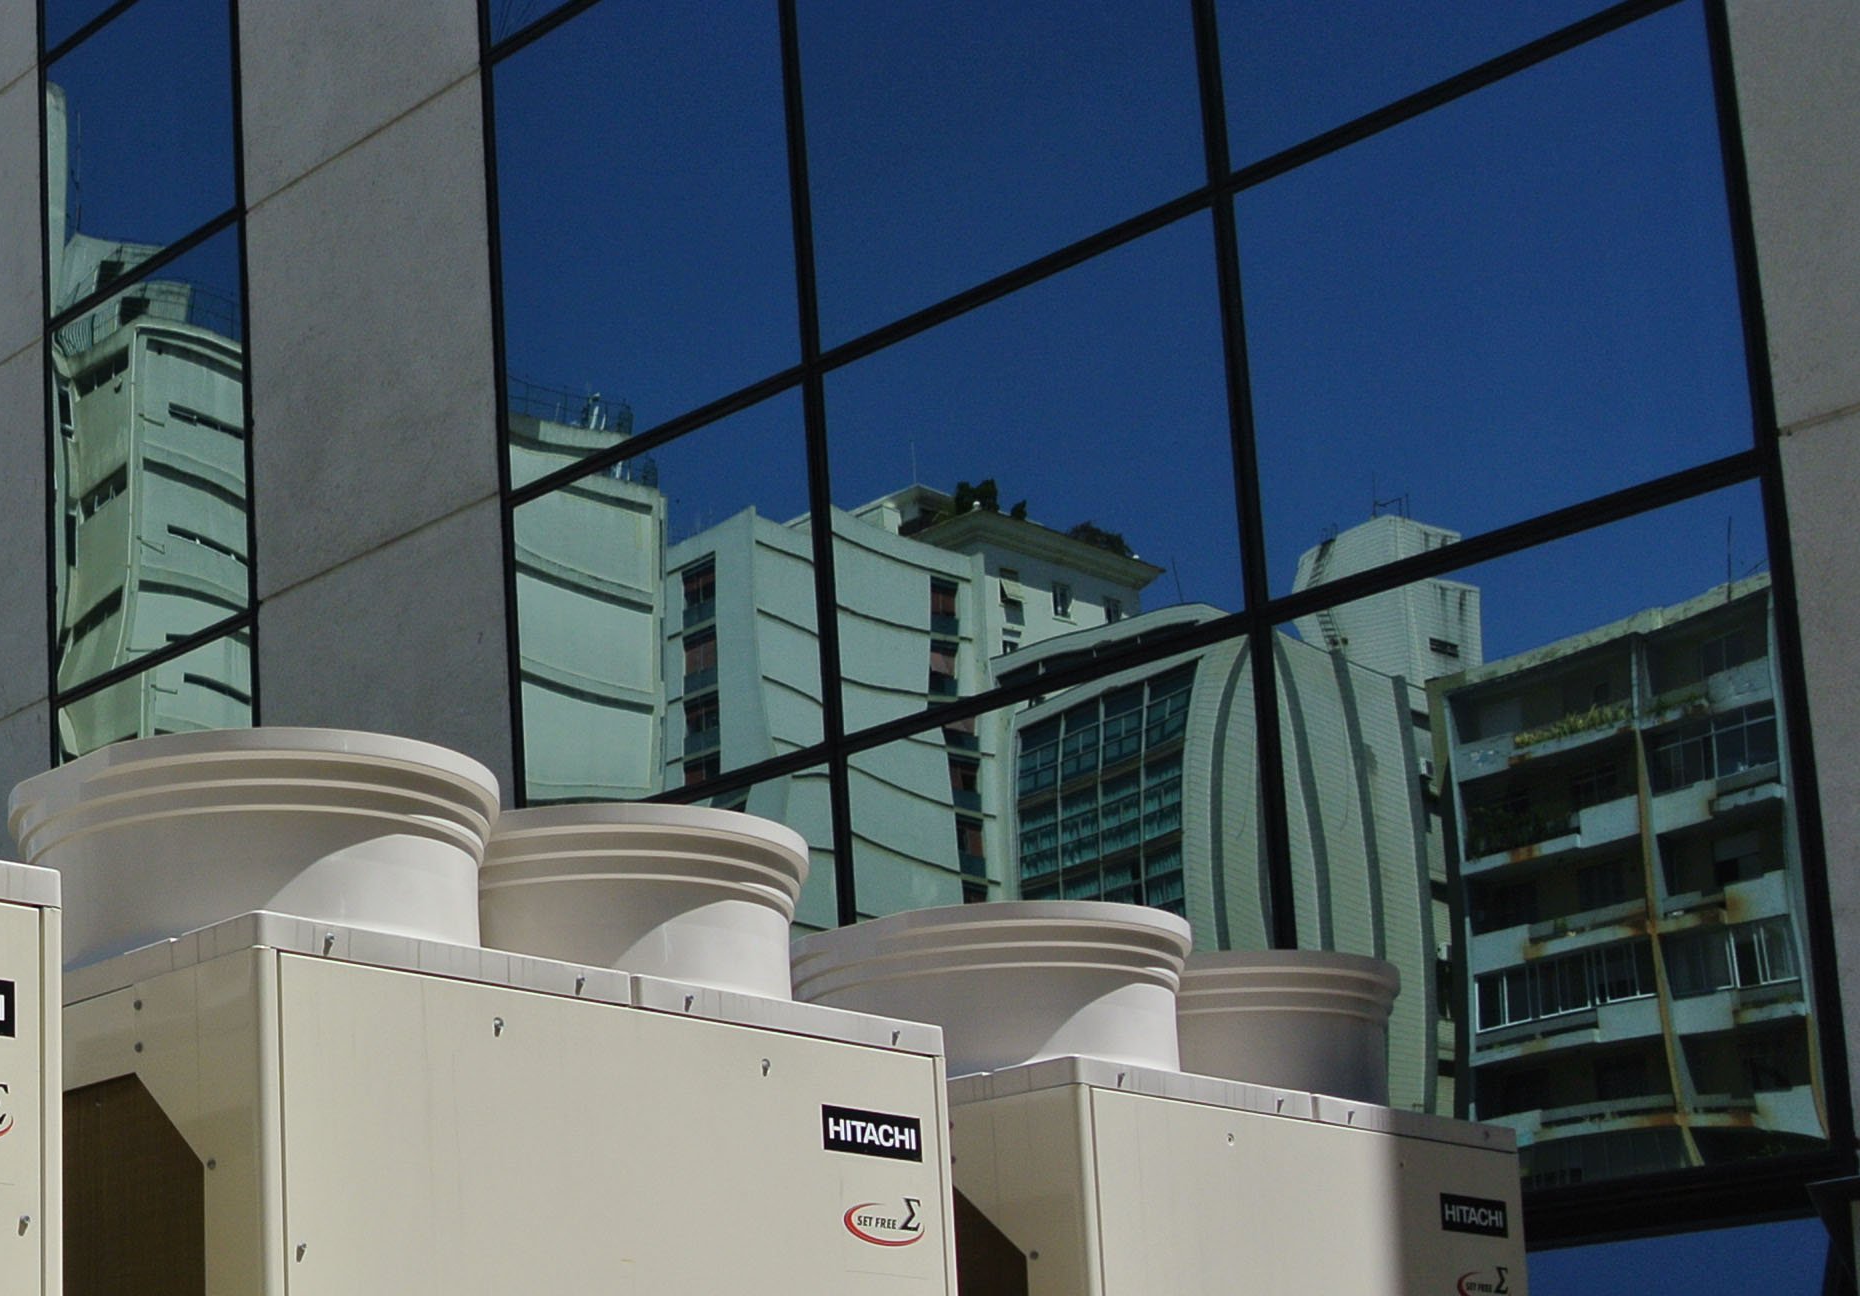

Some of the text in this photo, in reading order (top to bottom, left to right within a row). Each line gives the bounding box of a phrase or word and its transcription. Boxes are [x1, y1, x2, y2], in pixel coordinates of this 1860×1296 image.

[828, 1117, 917, 1150] HITACHI
[857, 1215, 873, 1227] SET
[875, 1217, 897, 1230] FREE
[1444, 1203, 1504, 1228] HITACHI
